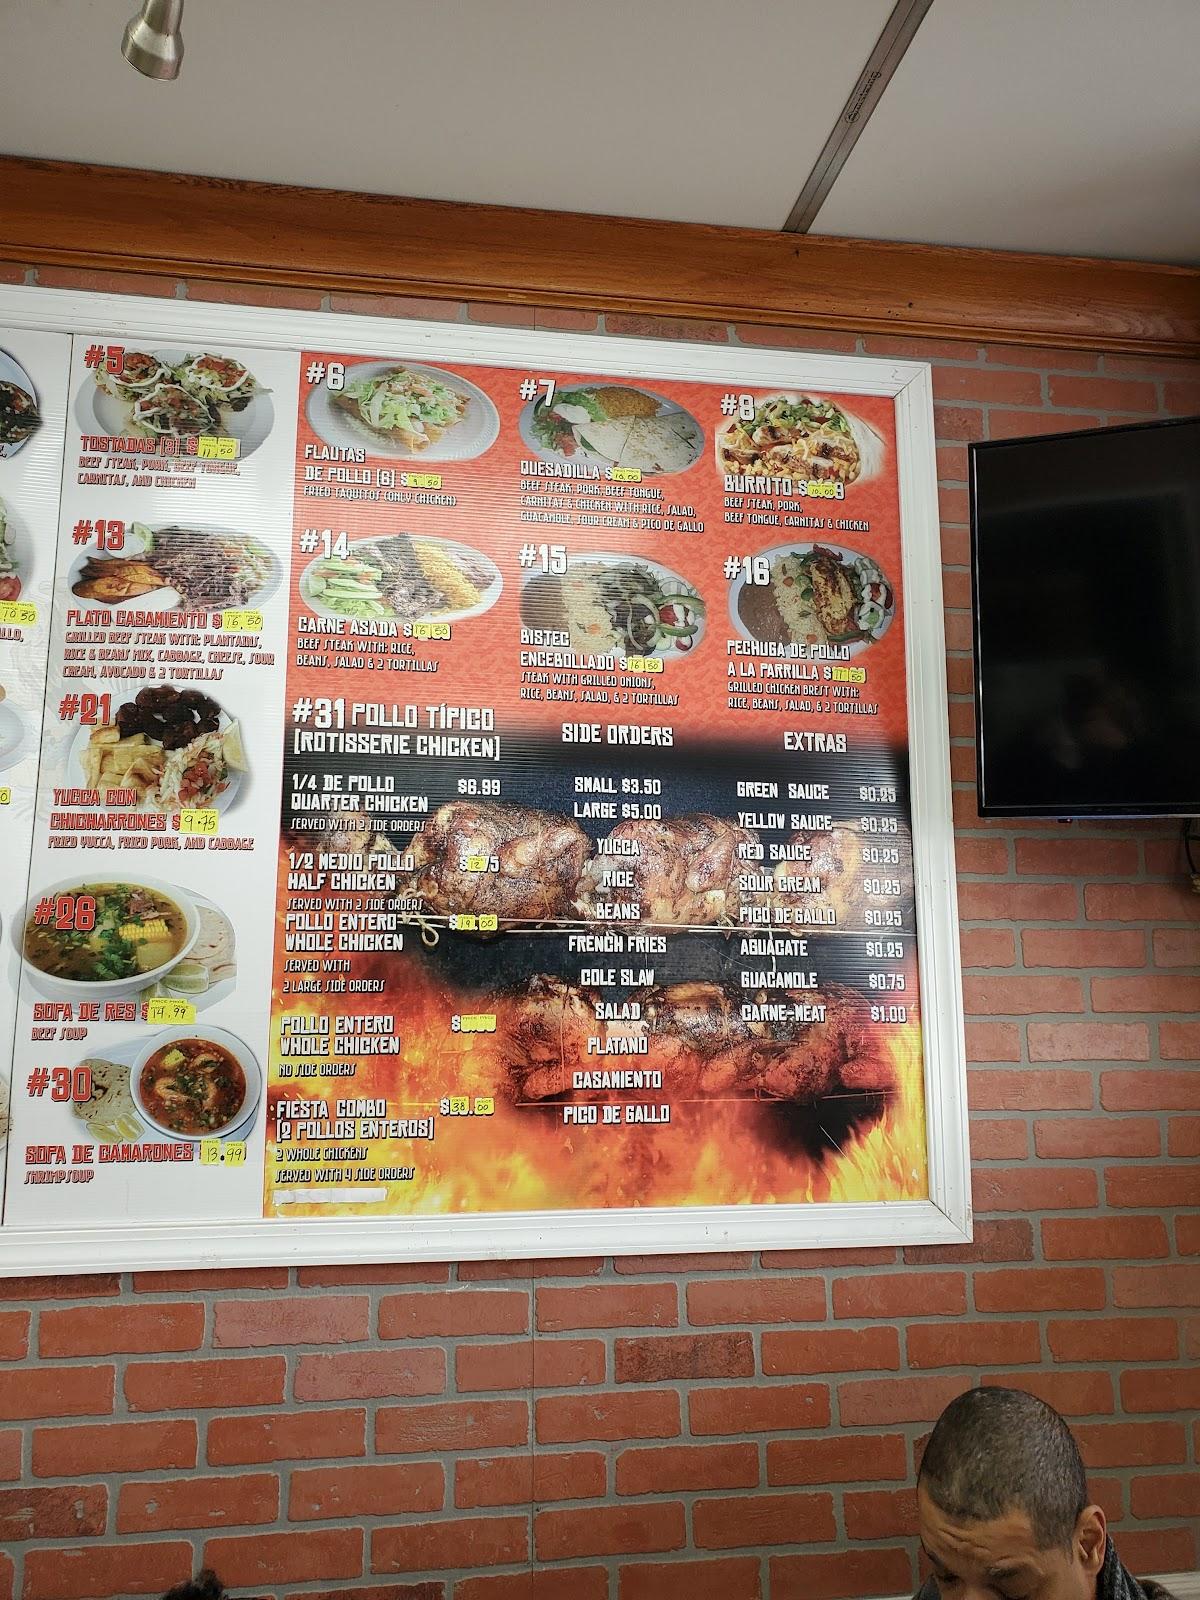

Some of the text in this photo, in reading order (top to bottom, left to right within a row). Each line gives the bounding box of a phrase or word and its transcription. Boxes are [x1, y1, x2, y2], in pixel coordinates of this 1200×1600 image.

[84, 344, 124, 375] #5
[306, 361, 345, 390] #6
[519, 379, 556, 406] #7
[720, 394, 755, 421] #8
[81, 436, 156, 454] TOSTADAS
[304, 445, 365, 463] FLAUTAS
[304, 466, 371, 484] DE POLLO
[520, 461, 600, 480] QUESADILLA
[724, 475, 792, 496] BURRITO
[304, 486, 457, 506] FRIED TAQUITOS (ONLY CHICKEN)
[520, 496, 564, 508] CARNITAS
[576, 499, 612, 511] CHICKEN
[615, 501, 640, 512] WITH
[642, 503, 664, 516] RICE,
[667, 505, 696, 517] SALAD,
[72, 520, 125, 550] #13
[300, 529, 350, 560] #14
[519, 544, 567, 574] #15
[724, 556, 770, 586] #16
[67, 610, 207, 629] PLATO CASAMIENTO
[298, 617, 398, 637] CARNE ASADA
[66, 632, 105, 643] GRILLED
[108, 633, 131, 644] BEEF
[134, 633, 166, 645] STEAK
[520, 630, 570, 646] BISTEC
[727, 640, 850, 660] PECHUGA DE POLLO
[520, 651, 615, 670] ENCEBOLLADO
[521, 672, 655, 689] STEAK WITH GRILLED ONIONS,
[728, 662, 819, 680] A LA PARRILLA
[728, 682, 859, 697] GRILLED CHICKEN BREST WITH:
[59, 693, 111, 725] #21
[292, 698, 495, 731] #31 POLLO TÍPICO
[562, 723, 673, 746] SIDE ORDERS
[784, 731, 847, 752] EXTRAS
[292, 773, 317, 790] 1/4
[323, 775, 343, 791] DE
[349, 776, 394, 793] POLLO
[575, 777, 661, 795] SMALL $3.50
[737, 782, 896, 803] GREEN SAUCE $0.25
[53, 789, 137, 806] YUCCA CON
[291, 794, 428, 812] QUARTER CHICKEN
[574, 802, 662, 820] LARGE $5.00
[50, 813, 167, 831] CHICHARRONES
[291, 818, 426, 832] SERVED WITH 2 SIDE ORDERS
[738, 812, 898, 833] YELLOW SAUCE $0.25
[48, 837, 255, 850] FRIED YUCCA, FRIED PORK, AND CABBAGE
[597, 838, 640, 856] YUCCA
[738, 843, 899, 863] RED SAUCE $0.25
[289, 853, 415, 871] 1/2 MEDIO POLLO
[603, 871, 634, 888] RICE
[739, 875, 900, 894] SOUR CREAM $0.25
[35, 895, 96, 932] #26
[596, 903, 640, 920] BEANS
[740, 907, 902, 926] PICO DE GALLO $0.25
[286, 914, 333, 931] POLLO
[339, 914, 397, 931] ENTERO
[285, 933, 403, 952] WHOLE CHICKEN
[568, 935, 667, 953] FRENCH FRIES
[741, 939, 903, 957] AGUACATE $0.25
[581, 969, 654, 986] COLE SLAW
[741, 971, 905, 990] GUACAMOLE $0.75
[33, 1002, 136, 1021] SOPA DE RES
[595, 1003, 641, 1020] SALAD
[741, 1005, 907, 1023] CARNE-MEAT $1.00
[31, 1028, 88, 1040] BEEF SOUP
[281, 1016, 394, 1035] POLLO ENTERO
[588, 1036, 648, 1054] PLATANO
[279, 1063, 356, 1077] NO SIDE ORDERS
[27, 1067, 92, 1101] #30
[573, 1071, 662, 1089] CASAMIENTO
[276, 1101, 328, 1119] FIESTA
[337, 1099, 386, 1117] COMBO
[564, 1105, 670, 1124] PICO DE GALLO
[25, 1146, 66, 1164] SOPA
[72, 1146, 94, 1163] DE
[99, 1143, 194, 1163] CAMARONES
[24, 1170, 94, 1184] SHRIMP SOUP
[275, 1167, 415, 1182] SERVED WITH 4 SIDE ORDERS
